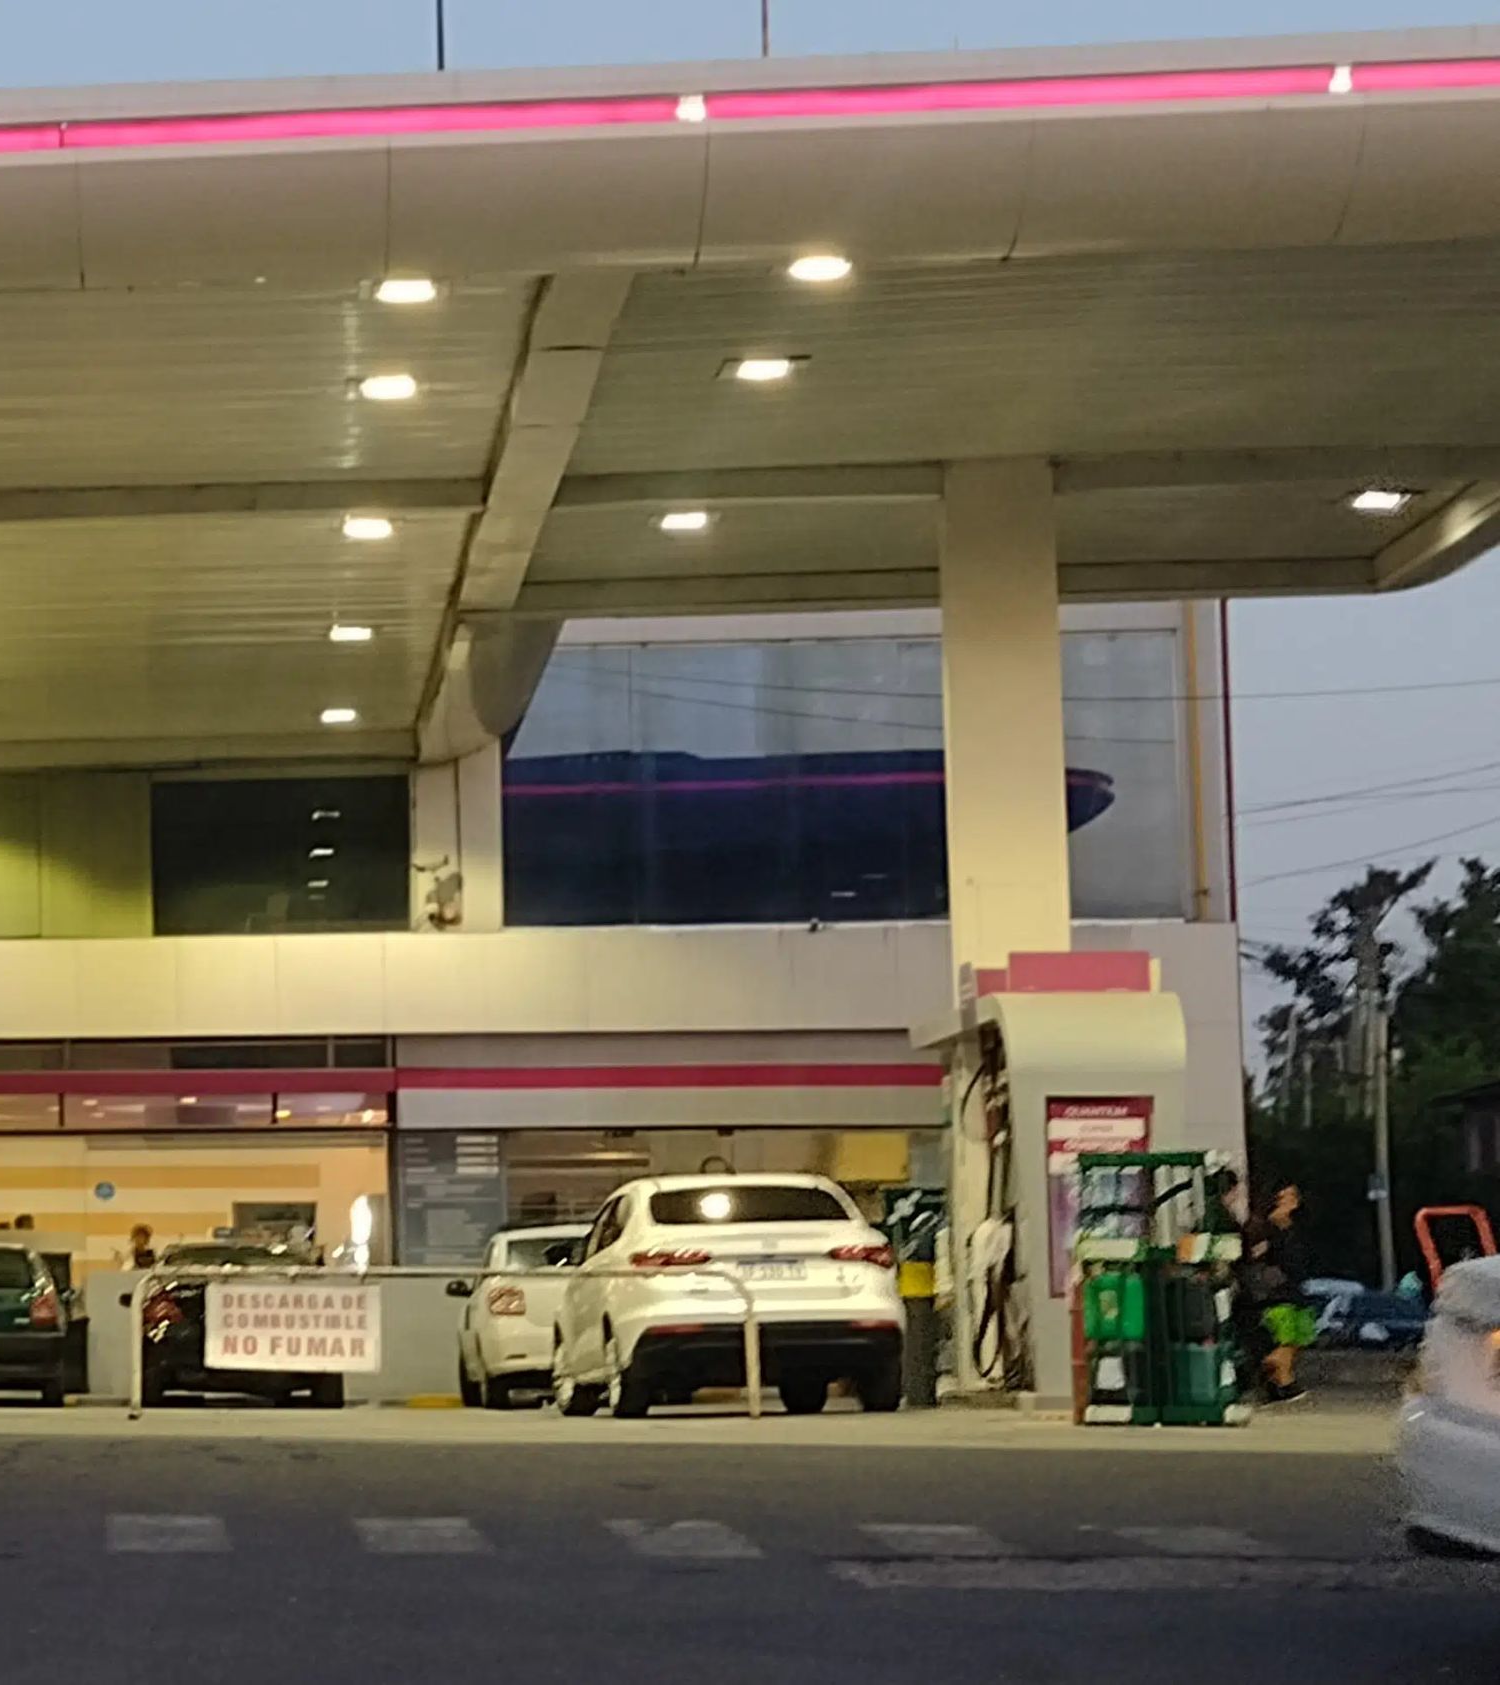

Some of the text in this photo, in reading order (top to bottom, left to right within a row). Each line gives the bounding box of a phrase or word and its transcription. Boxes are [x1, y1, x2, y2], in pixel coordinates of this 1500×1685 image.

[222, 1293, 367, 1310] DESCARGA DE
[222, 1313, 367, 1330] COMBUSTIBLE
[221, 1335, 366, 1357] NO FUMAR
